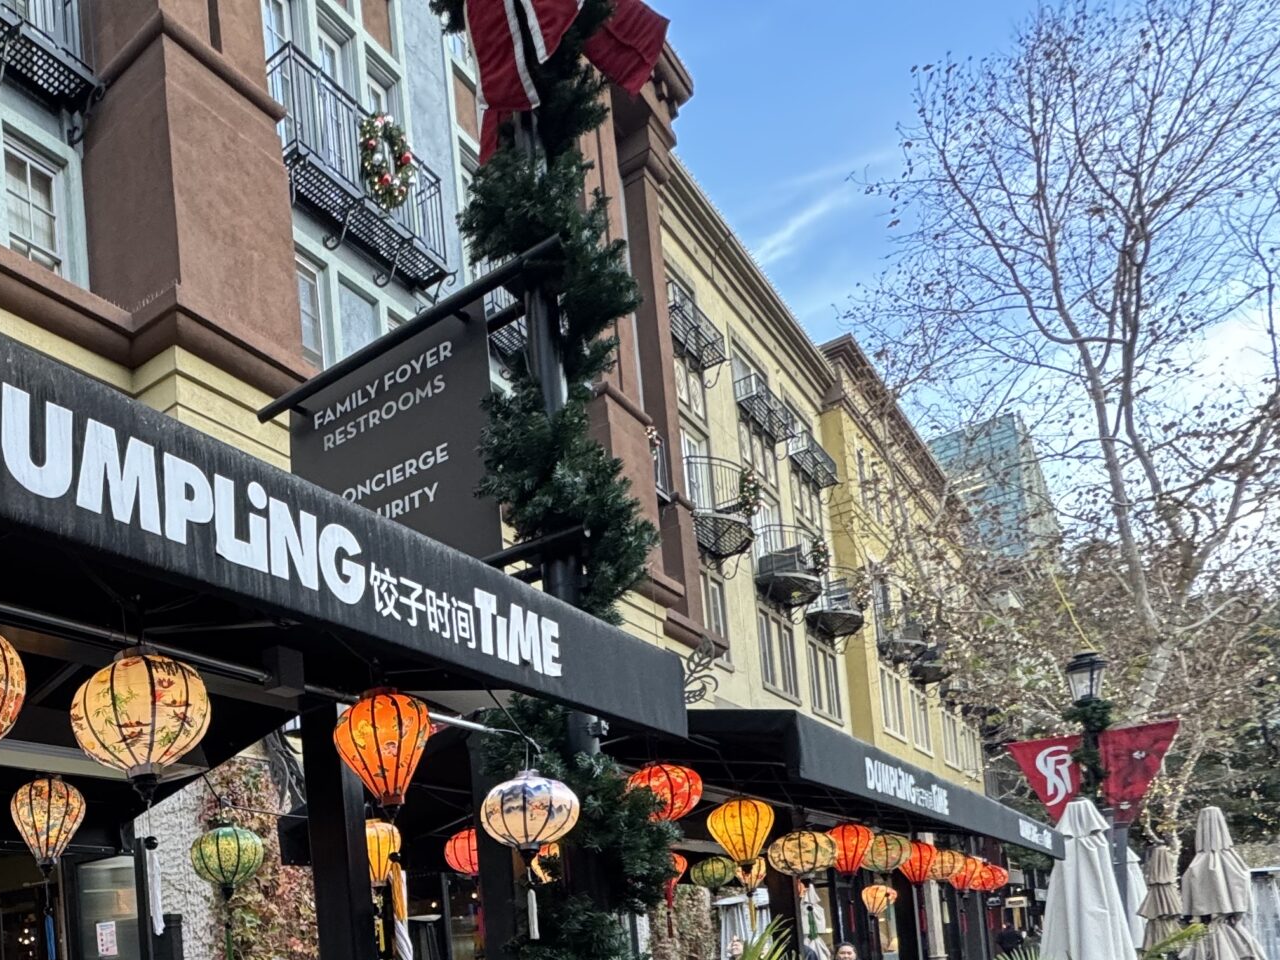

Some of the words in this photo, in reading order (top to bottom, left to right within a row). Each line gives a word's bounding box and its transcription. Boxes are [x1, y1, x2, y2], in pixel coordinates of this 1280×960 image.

[313, 378, 380, 430] FAMILY
[384, 341, 453, 391] FOYER
[323, 374, 446, 451] RESTROOMS
[341, 442, 449, 503] ONCIERGE
[370, 562, 477, 649] 饺子时间
